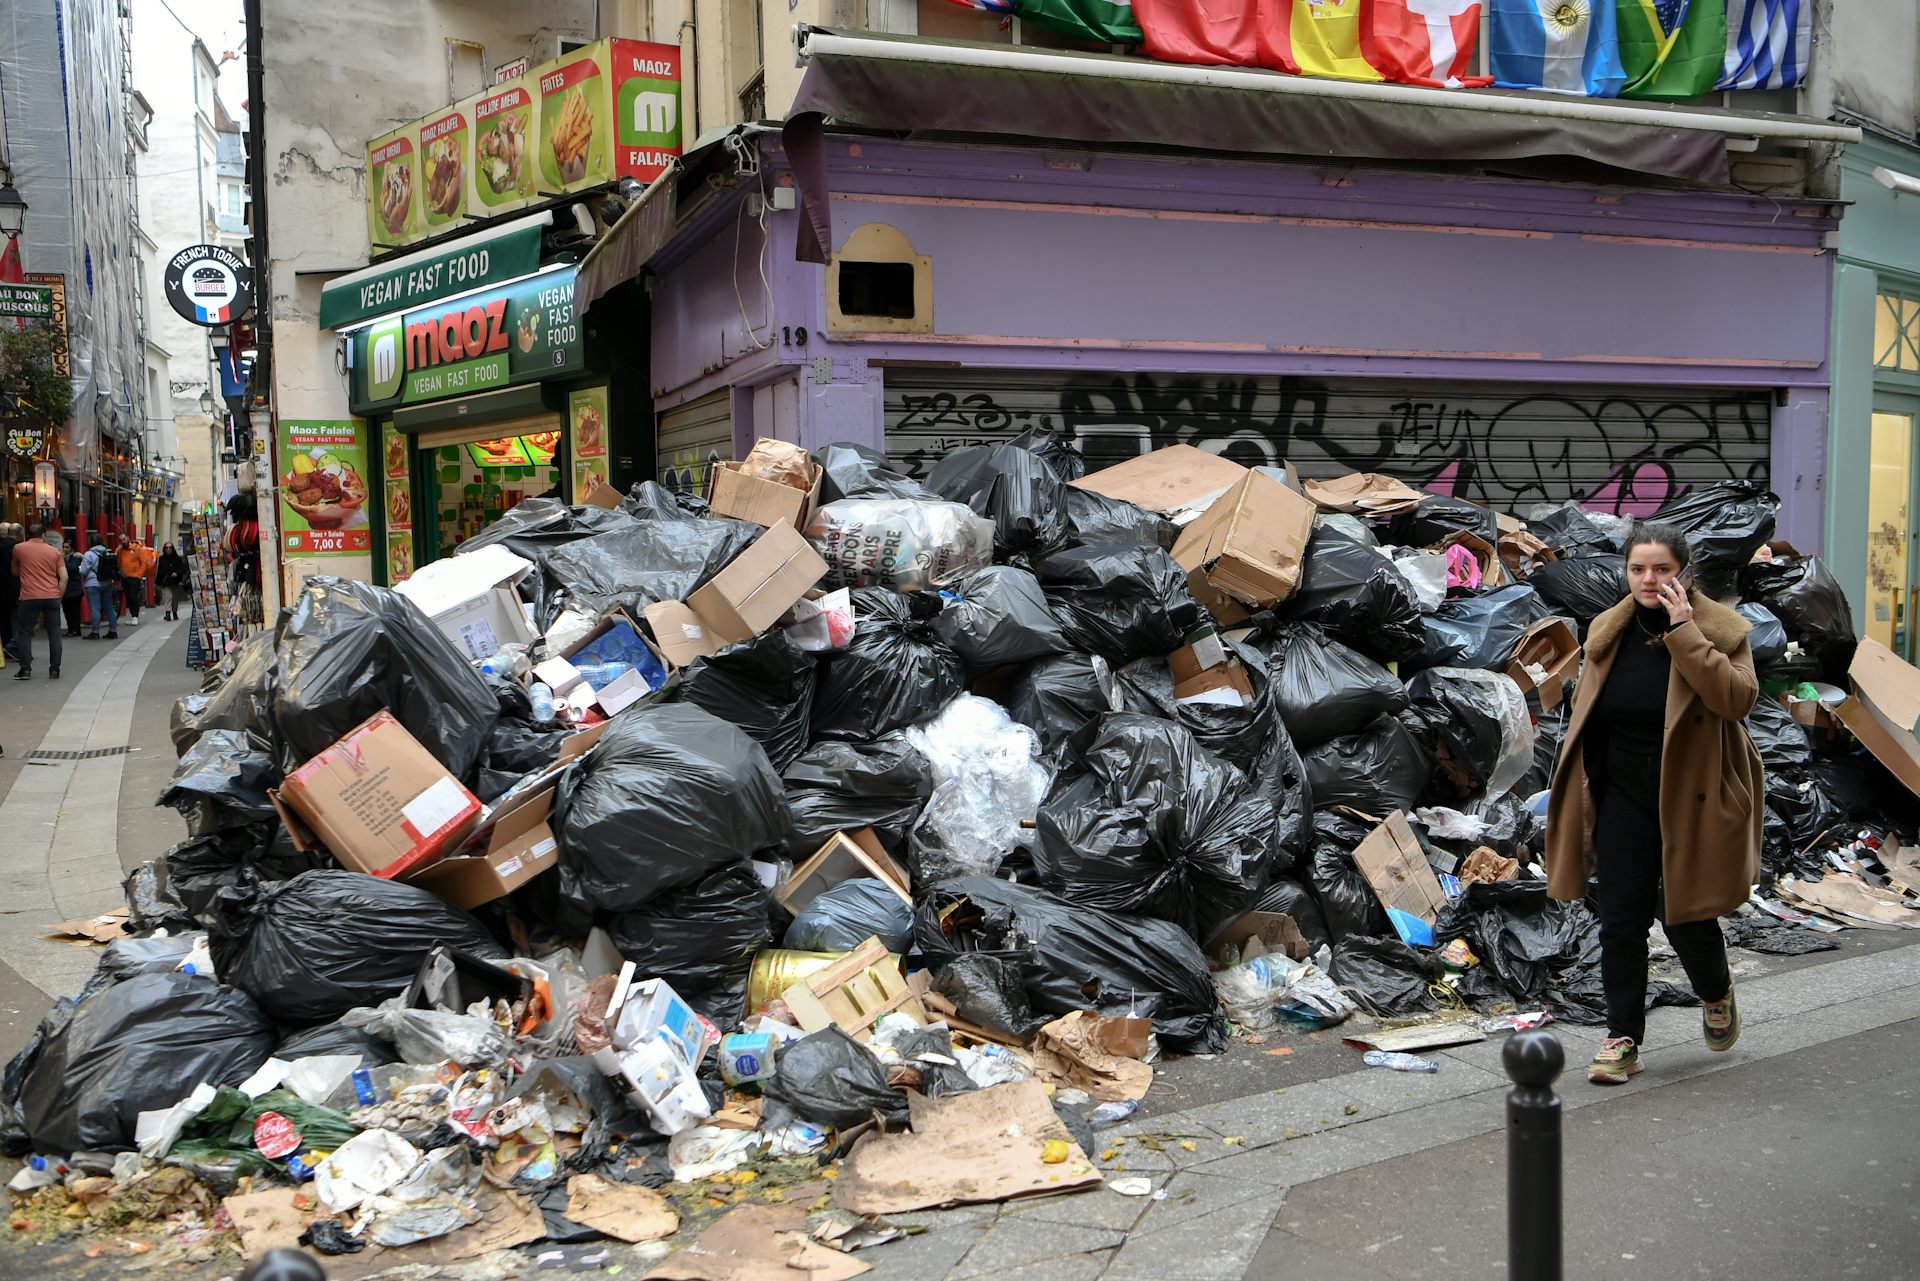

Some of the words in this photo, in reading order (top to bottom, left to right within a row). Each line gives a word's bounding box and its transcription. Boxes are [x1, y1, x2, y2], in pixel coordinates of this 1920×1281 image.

[633, 58, 672, 76] MAOZ
[541, 73, 565, 94] FRITES
[477, 99, 499, 119] SALADE
[500, 91, 520, 109] MENU
[421, 126, 437, 143] MAOZ
[437, 116, 459, 137] FALAFEL
[630, 151, 676, 167] FALAFE
[172, 246, 209, 270] FRENCH
[212, 247, 243, 271] TOQUE
[195, 283, 226, 292] BURGER
[360, 275, 403, 309] VEGAN
[407, 263, 443, 296] FAST
[448, 250, 489, 285] FOOD
[15, 290, 39, 300] BON
[538, 284, 575, 308] VEGAN
[549, 304, 575, 326] FAST
[406, 298, 509, 371] maoz
[547, 324, 576, 347] FOOD
[783, 326, 807, 346] 19
[414, 375, 442, 394] VEGAN
[447, 369, 469, 388] FAST
[474, 363, 499, 382] FOOD
[289, 425, 318, 435] Maoz
[320, 426, 355, 435] Falafel
[313, 538, 334, 551] 7,00
[335, 538, 343, 549] €
[861, 535, 881, 577] PARIS
[880, 530, 902, 586] PROPRE
